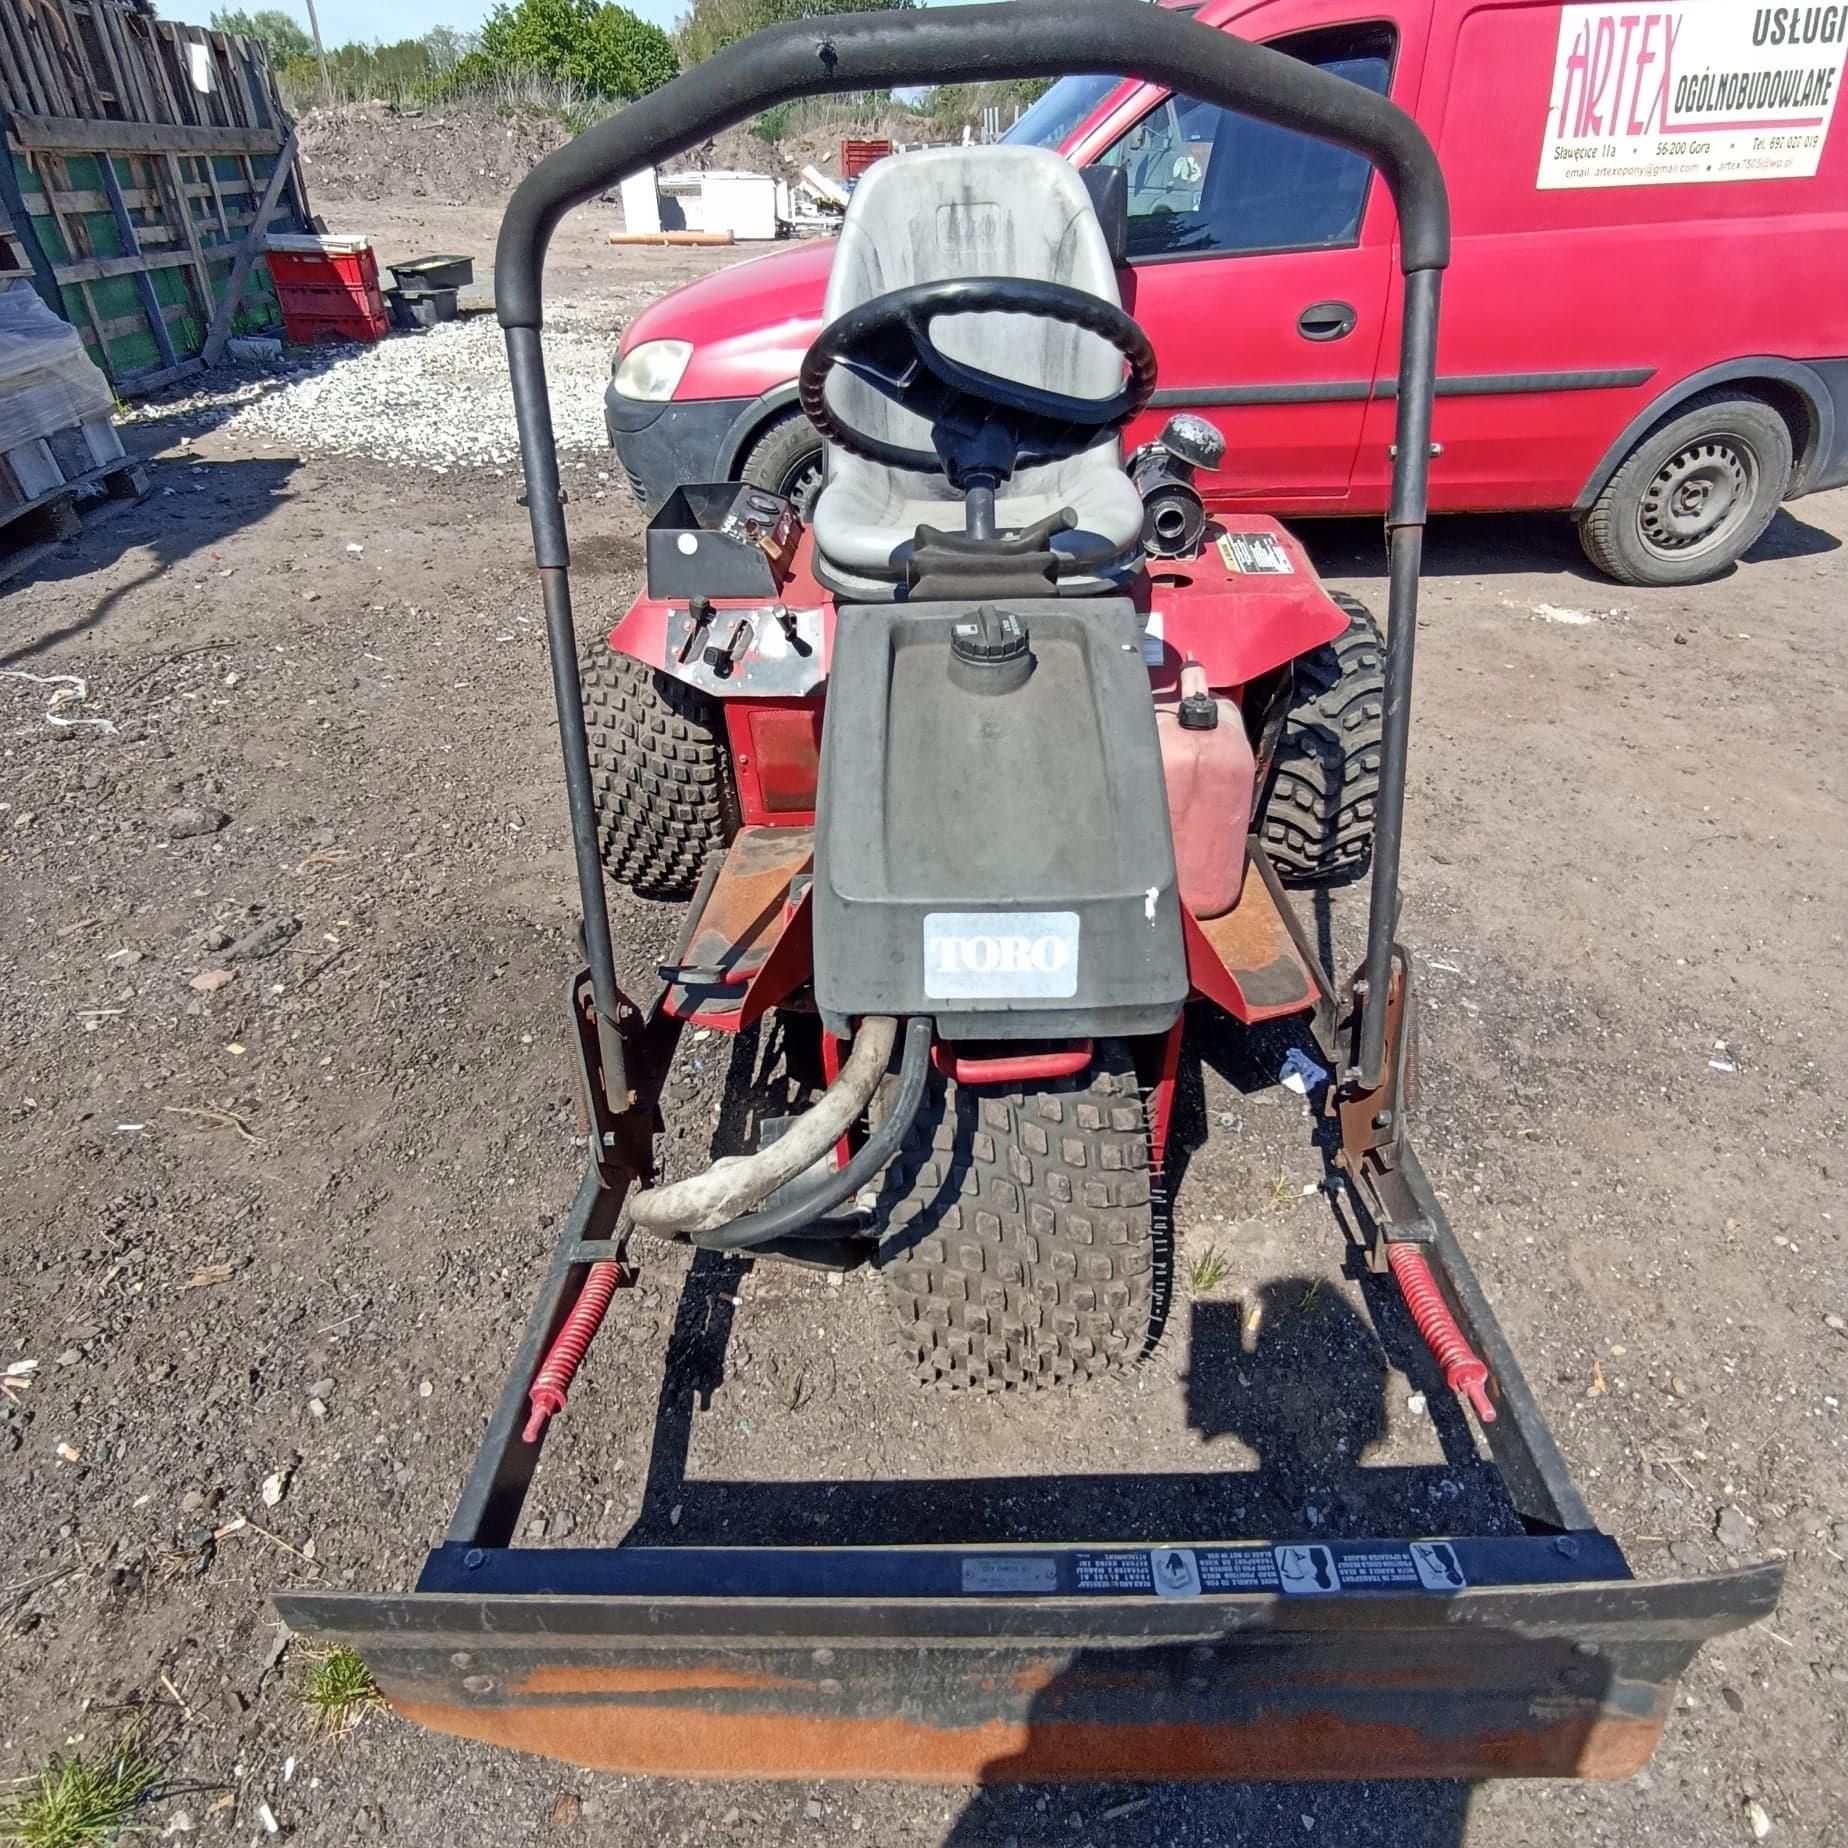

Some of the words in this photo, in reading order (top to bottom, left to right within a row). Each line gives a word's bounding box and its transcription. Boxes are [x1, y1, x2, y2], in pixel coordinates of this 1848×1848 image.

[1752, 5, 1848, 46] USŁUGI
[1557, 14, 1683, 139] ARTEX
[1674, 66, 1836, 114] OGÓLNOBUDOWLANE
[928, 935, 1071, 974] TORO
